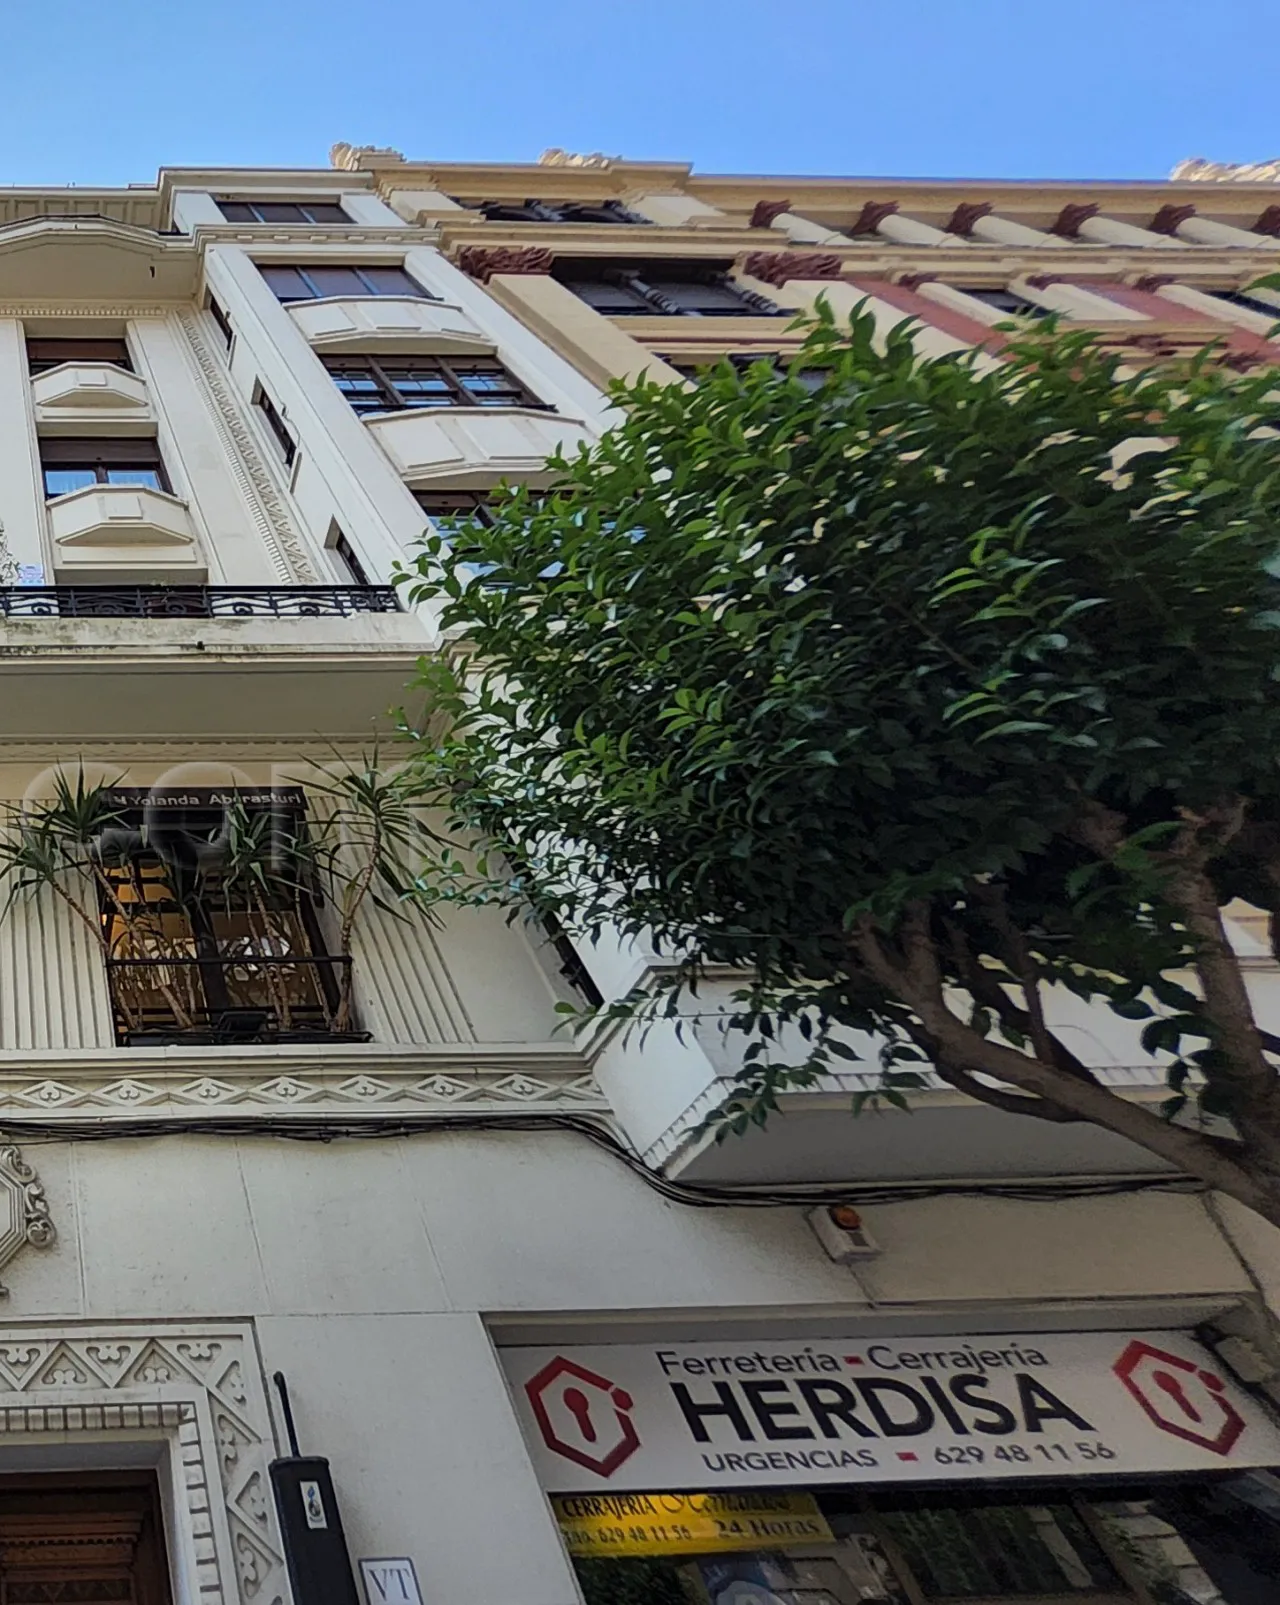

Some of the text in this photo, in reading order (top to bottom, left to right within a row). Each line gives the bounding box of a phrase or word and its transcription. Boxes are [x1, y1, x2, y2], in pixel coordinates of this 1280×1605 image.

[129, 794, 200, 806] Yolanda
[656, 1343, 1048, 1376] Ferretería Cerrajería
[669, 1373, 1099, 1443] HERDISA
[701, 1442, 1116, 1473] URGENCIAS 629 48 11 56
[597, 1527, 625, 1544] 629
[628, 1526, 645, 1542] 48
[650, 1525, 669, 1541] 11
[675, 1524, 692, 1540] 56
[713, 1519, 745, 1538] 24
[747, 1518, 821, 1538] Horas
[368, 1568, 411, 1601] VT
